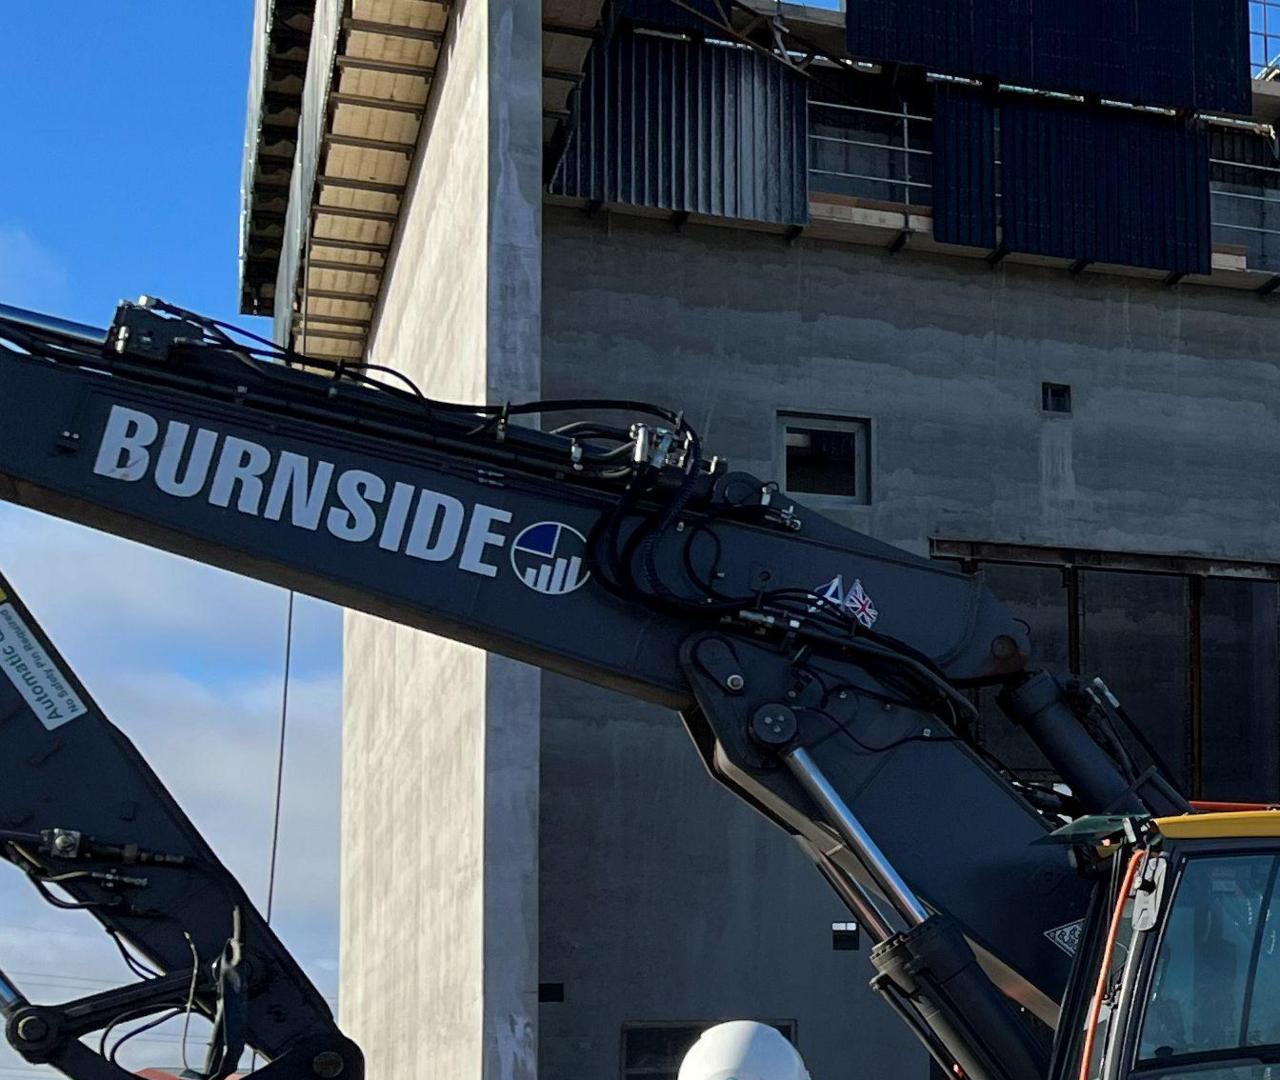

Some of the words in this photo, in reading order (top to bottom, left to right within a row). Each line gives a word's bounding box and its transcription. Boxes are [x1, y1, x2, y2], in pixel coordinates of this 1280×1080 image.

[93, 404, 513, 578] BURNSIDE
[1, 609, 33, 652] Required
[32, 653, 46, 668] Pin
[2, 645, 63, 720] Automatic
[44, 668, 68, 698] Safety
[65, 698, 79, 713] No
